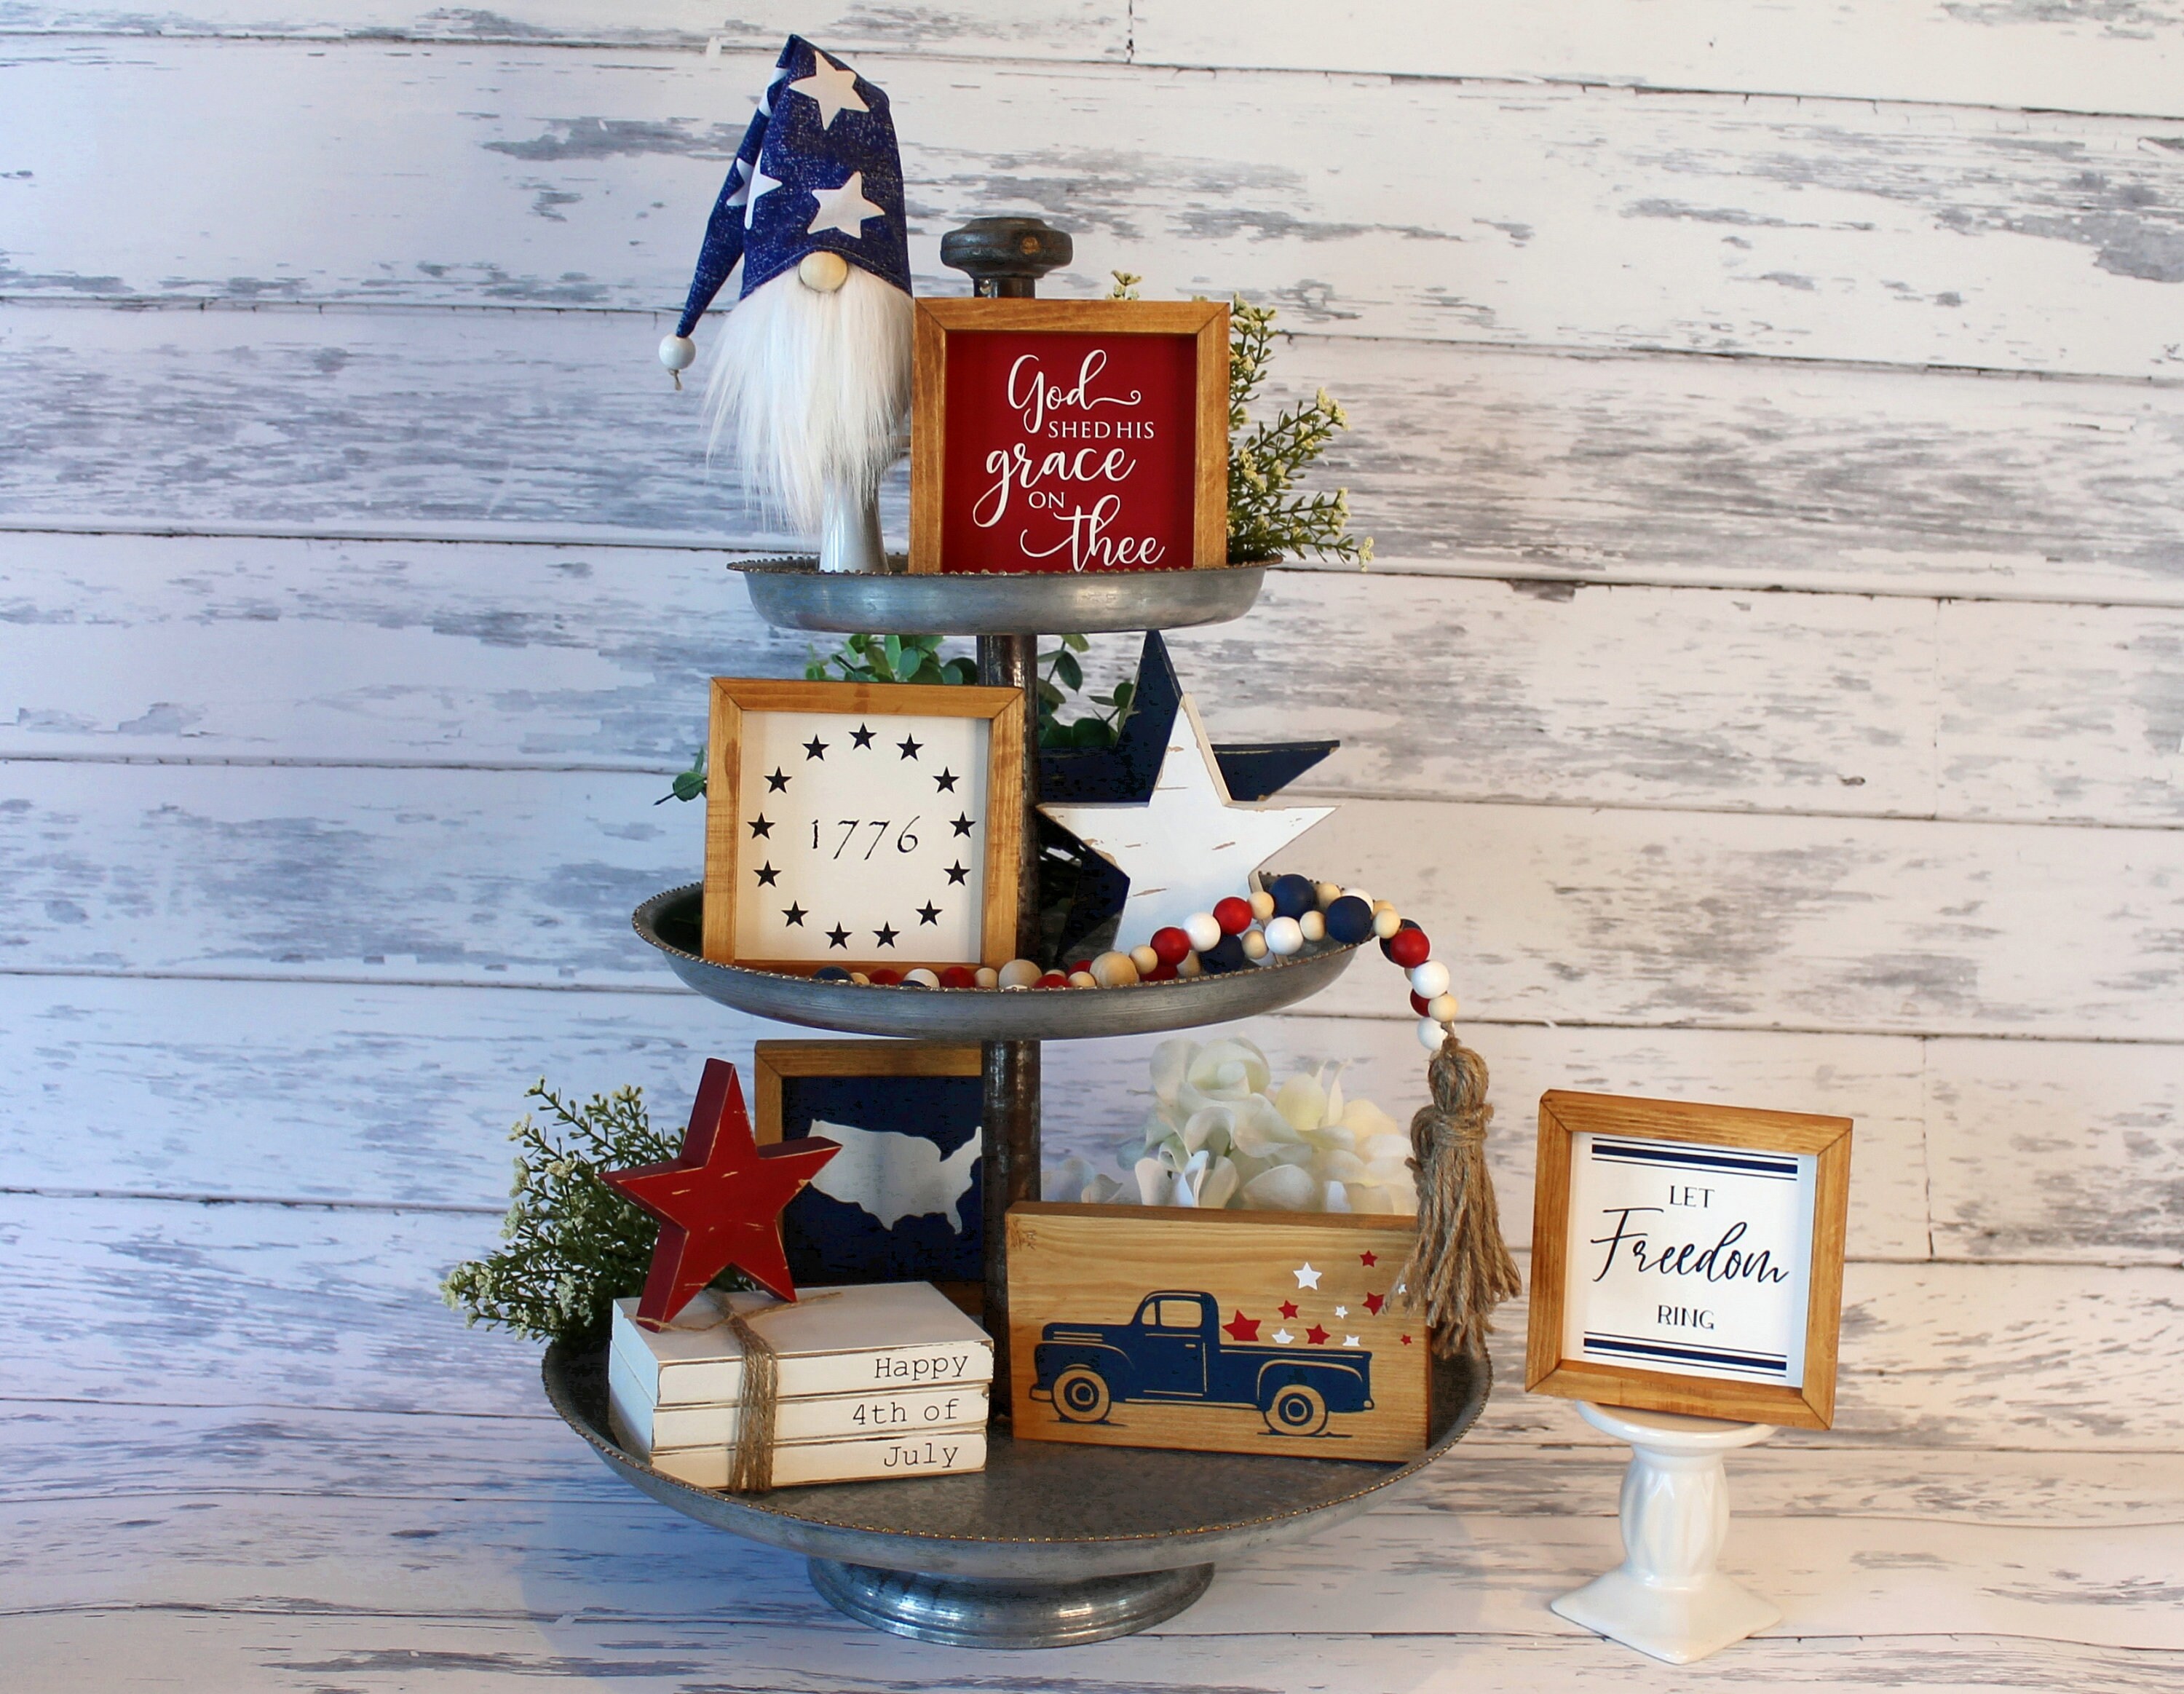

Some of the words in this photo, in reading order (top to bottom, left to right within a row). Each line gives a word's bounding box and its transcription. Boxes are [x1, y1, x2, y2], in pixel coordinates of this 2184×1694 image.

[1008, 349, 1142, 434] God
[1048, 421, 1111, 438] SHED
[1117, 421, 1155, 439] HIS
[973, 443, 1136, 528] grace
[1028, 491, 1064, 509] ON
[1020, 494, 1165, 573] thee
[811, 815, 921, 860] 1776
[1669, 1185, 1715, 1208] LET
[1590, 1207, 1789, 1283] Freedom
[1657, 1304, 1715, 1330] RING
[874, 1355, 968, 1381] Happy
[852, 1402, 908, 1425] 4th
[923, 1398, 960, 1421] of
[883, 1442, 960, 1468] July
